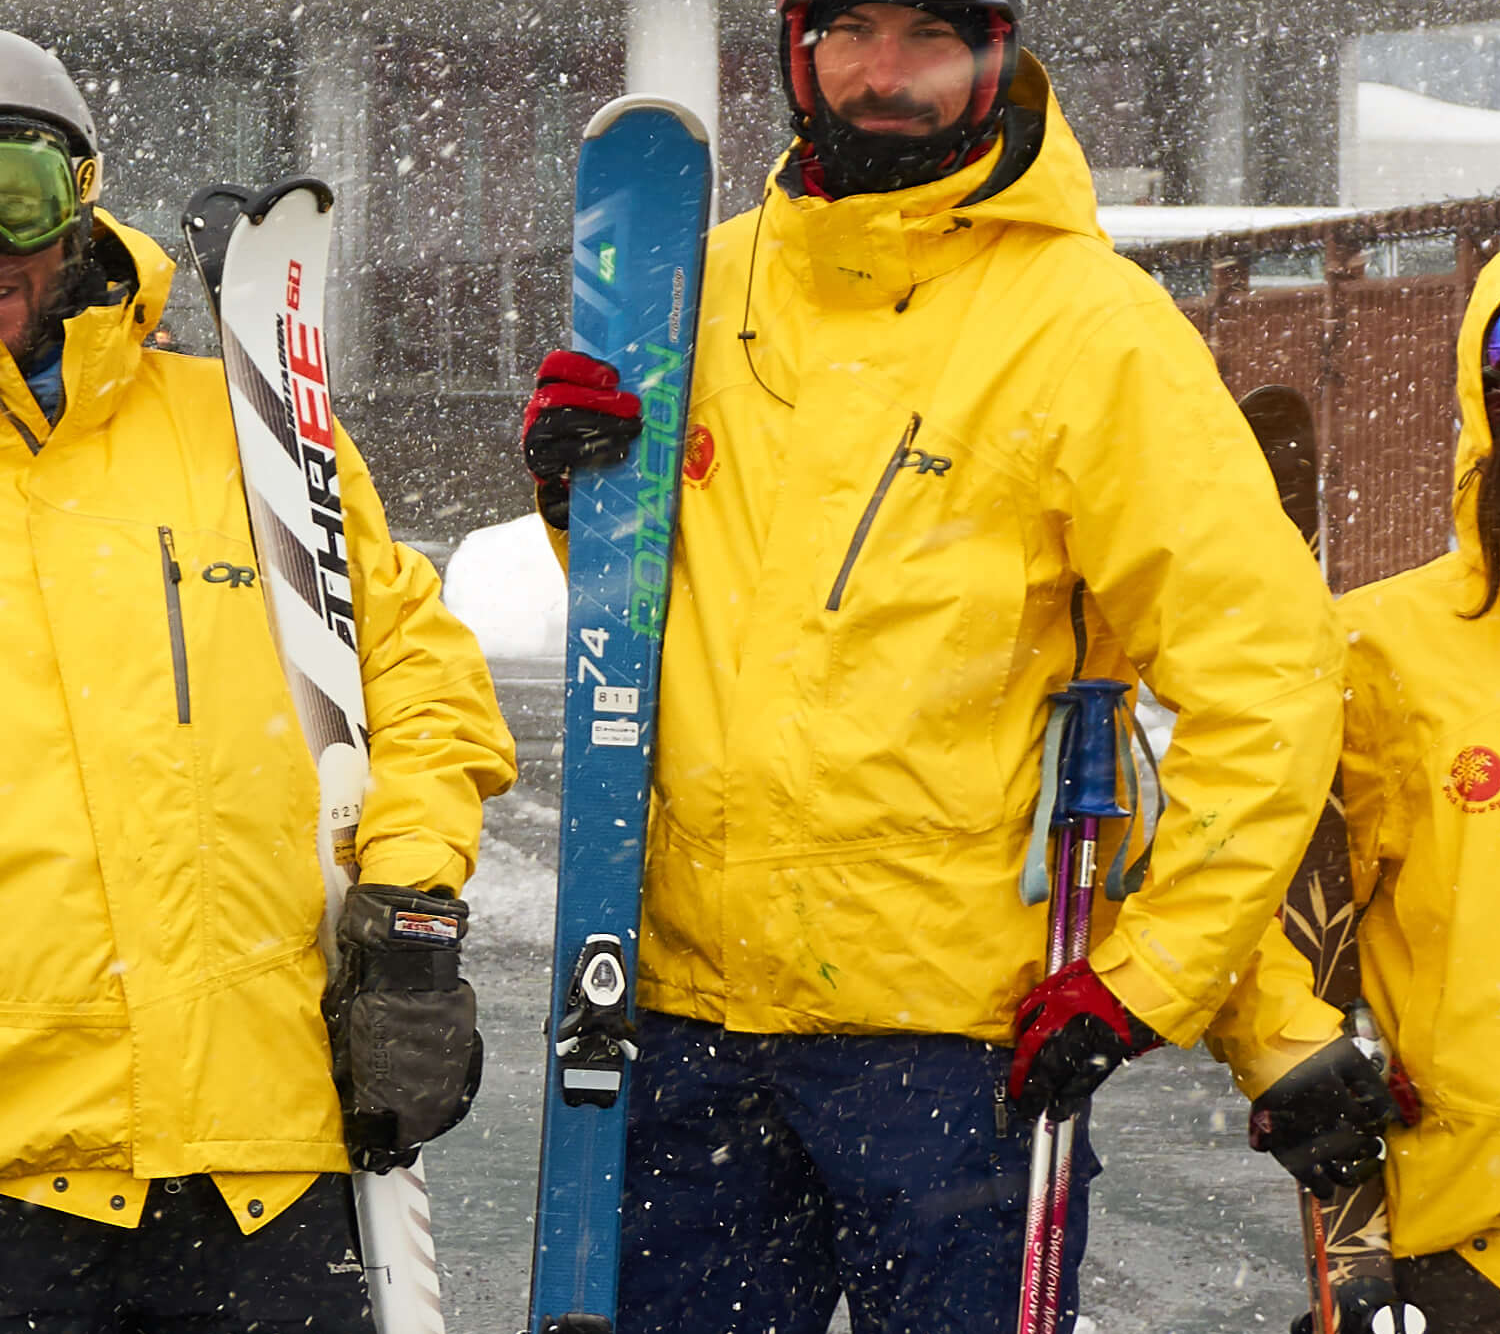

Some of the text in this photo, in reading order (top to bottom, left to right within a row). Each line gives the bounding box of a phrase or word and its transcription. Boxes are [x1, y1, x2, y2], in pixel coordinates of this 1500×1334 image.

[285, 259, 303, 312] 60
[630, 342, 684, 640] ROTACION
[201, 561, 256, 589] OR
[578, 626, 610, 686] 74
[1044, 1224, 1064, 1304] Swallow
